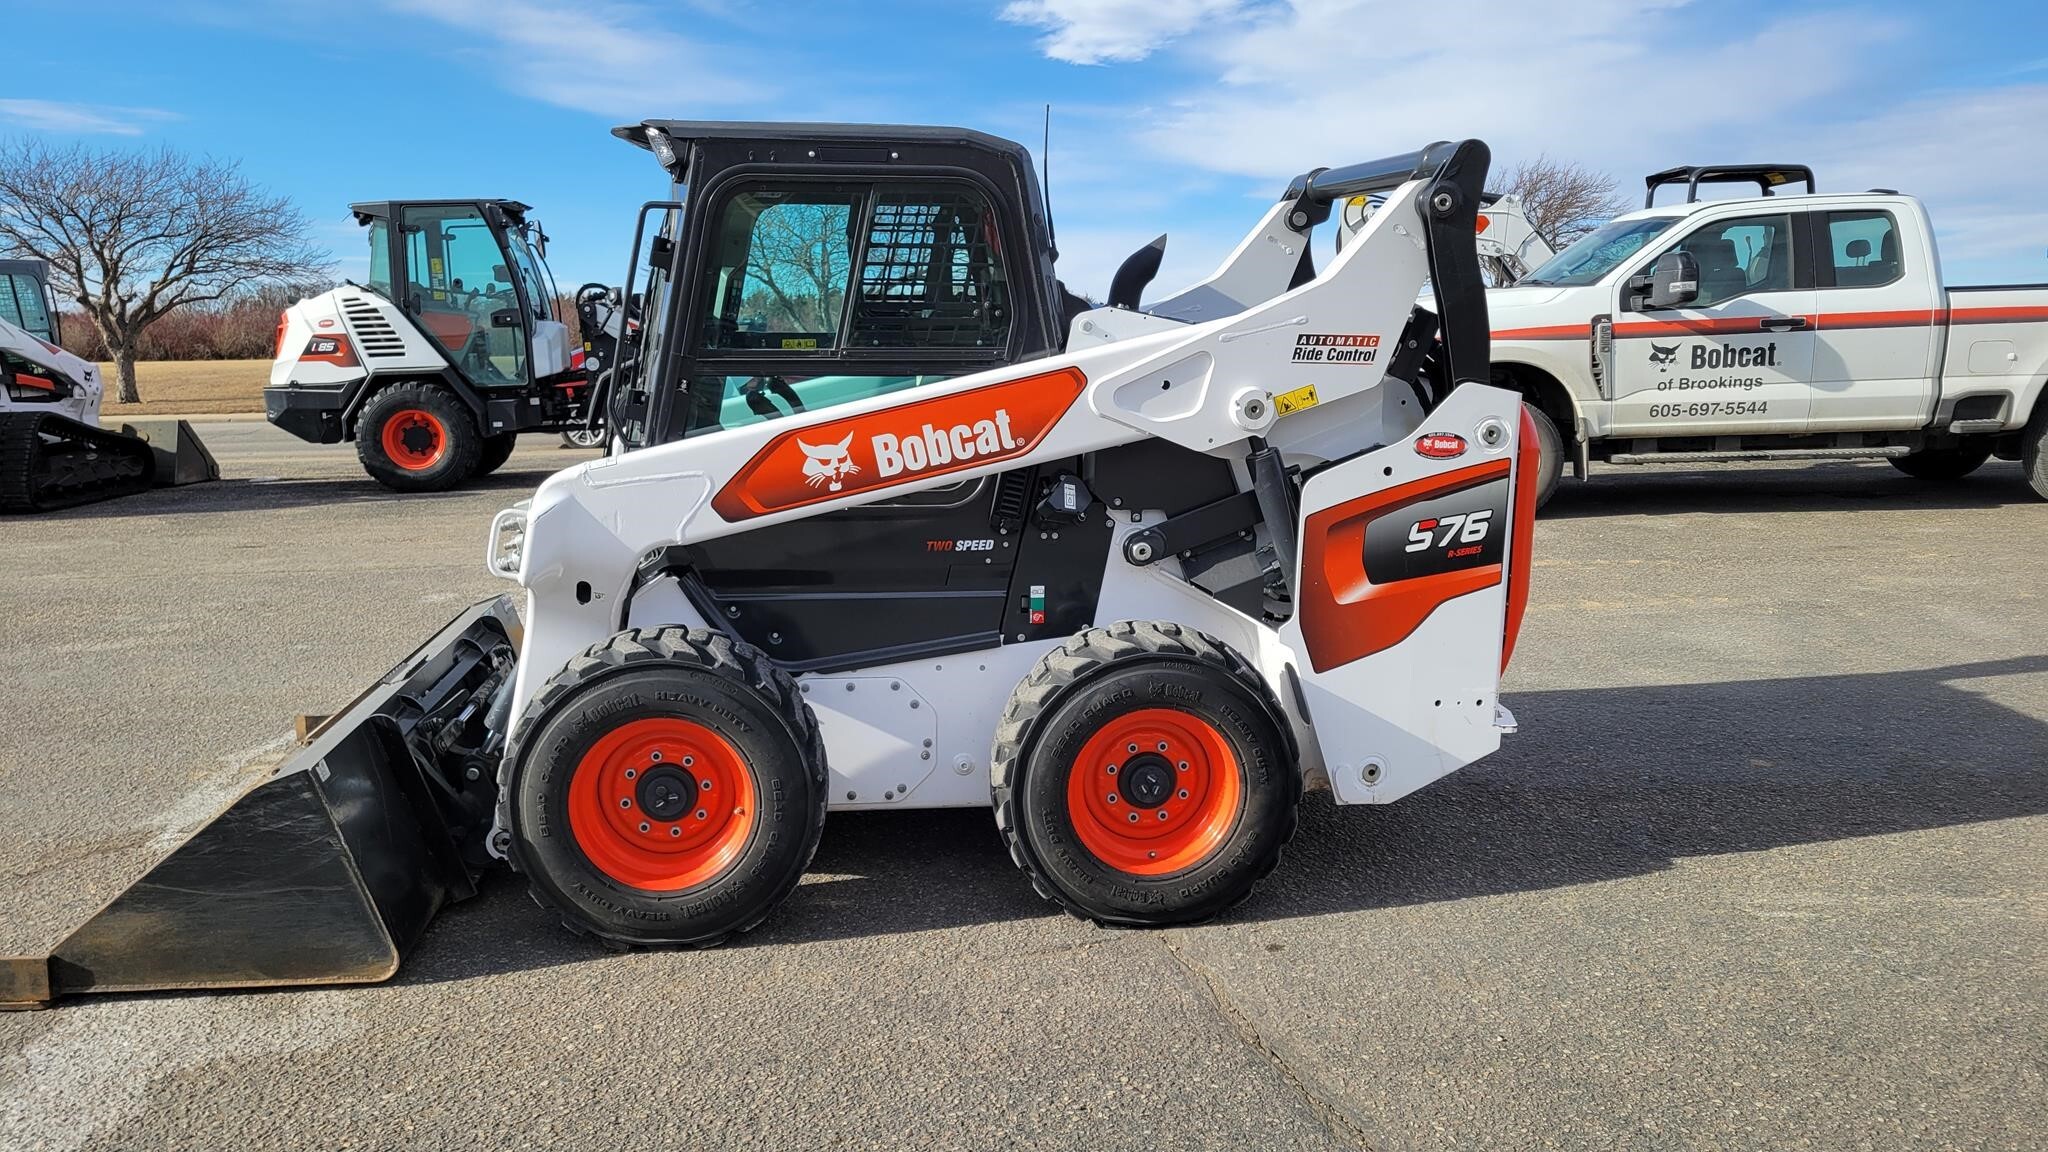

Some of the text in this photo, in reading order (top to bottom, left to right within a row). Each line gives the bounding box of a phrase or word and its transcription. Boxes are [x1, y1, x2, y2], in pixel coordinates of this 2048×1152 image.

[1299, 335, 1378, 346] AUTOMATIC
[1292, 347, 1377, 361] Ride Control
[1691, 343, 1777, 369] Bobcat
[1657, 376, 1763, 391] of Brookings
[1649, 401, 1768, 418] 605-697-5544
[872, 408, 1016, 478] Bobcat
[1405, 510, 1493, 552] S76
[927, 540, 994, 551] TWO SPEED
[1447, 545, 1483, 558] R-SERIES
